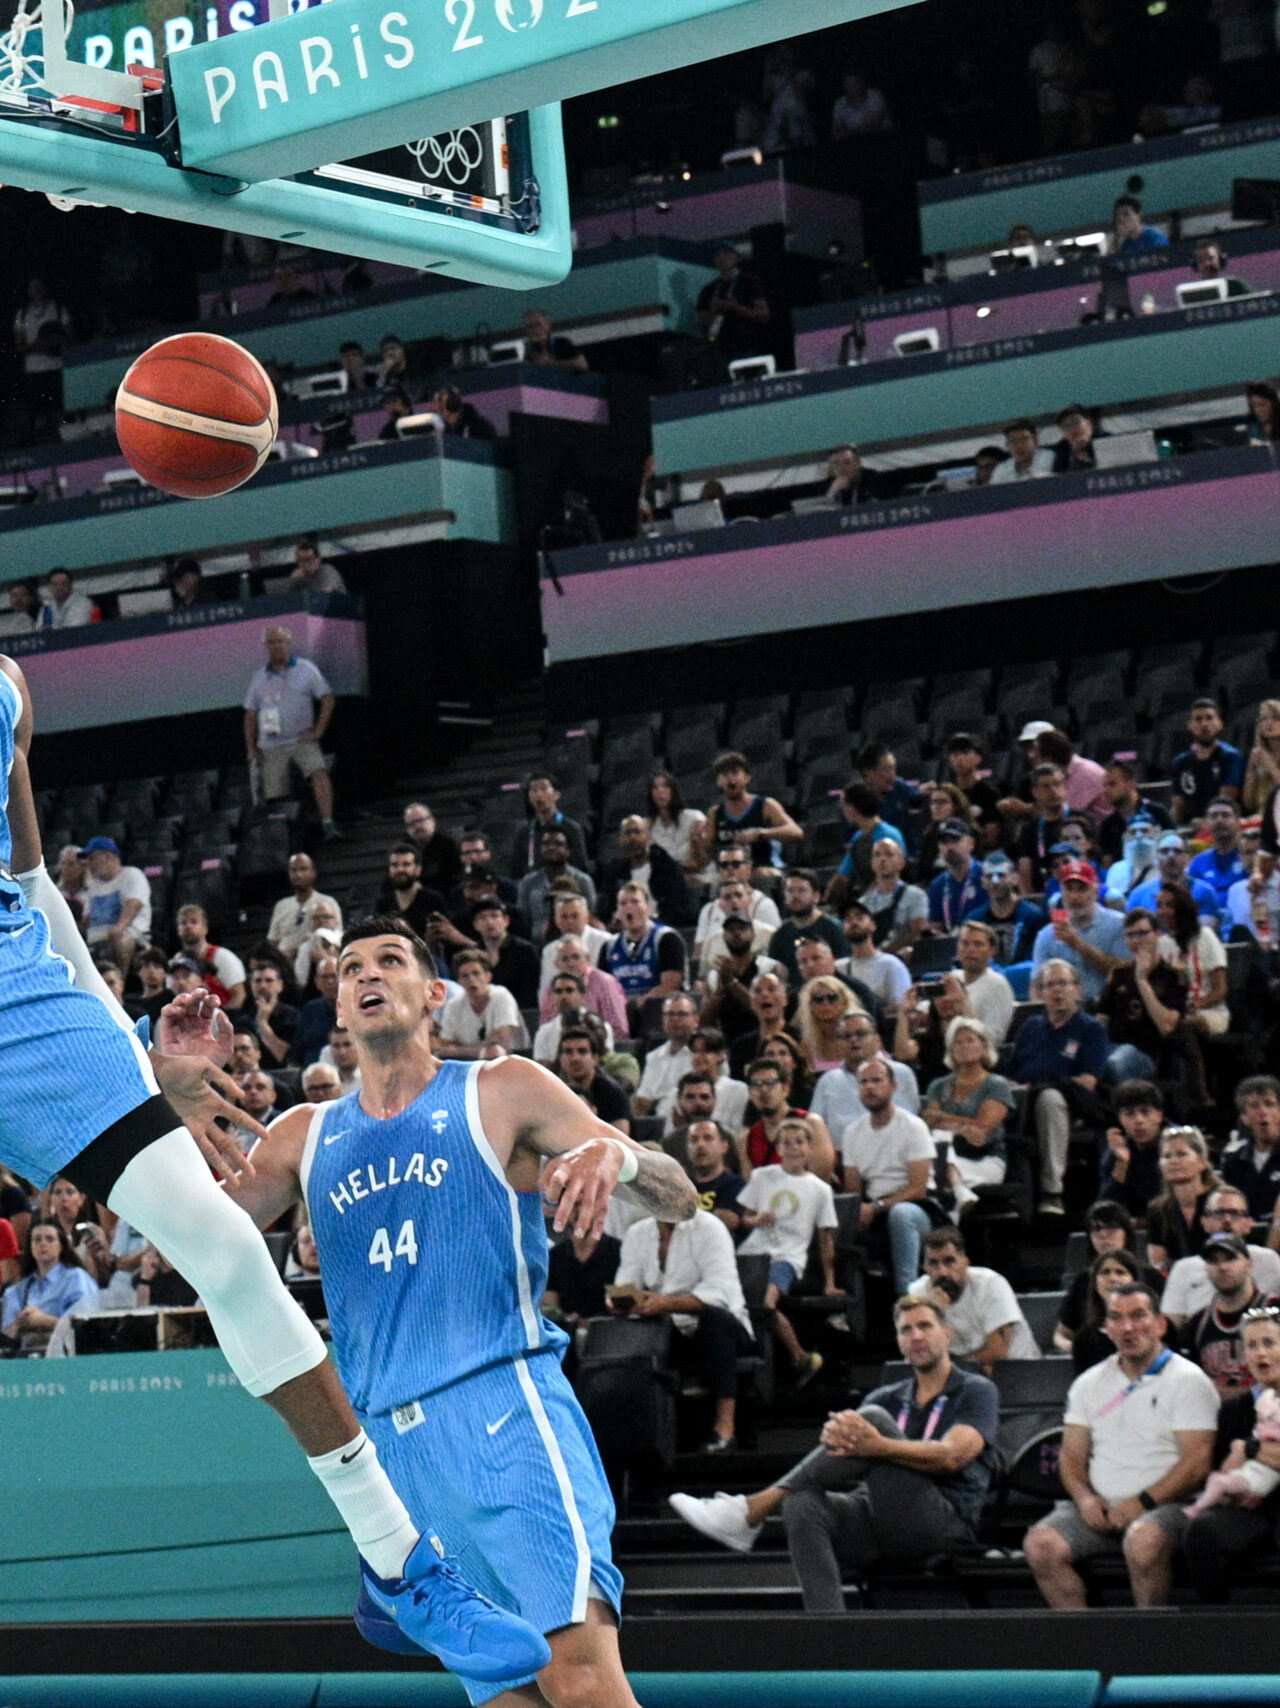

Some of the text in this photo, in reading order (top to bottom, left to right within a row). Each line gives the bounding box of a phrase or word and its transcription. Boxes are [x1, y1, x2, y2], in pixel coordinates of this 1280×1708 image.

[329, 1152, 449, 1215] HELLAS
[368, 1219, 419, 1273] 44
[25, 1381, 67, 1398] 2024
[89, 1375, 184, 1394] PARIS 2024
